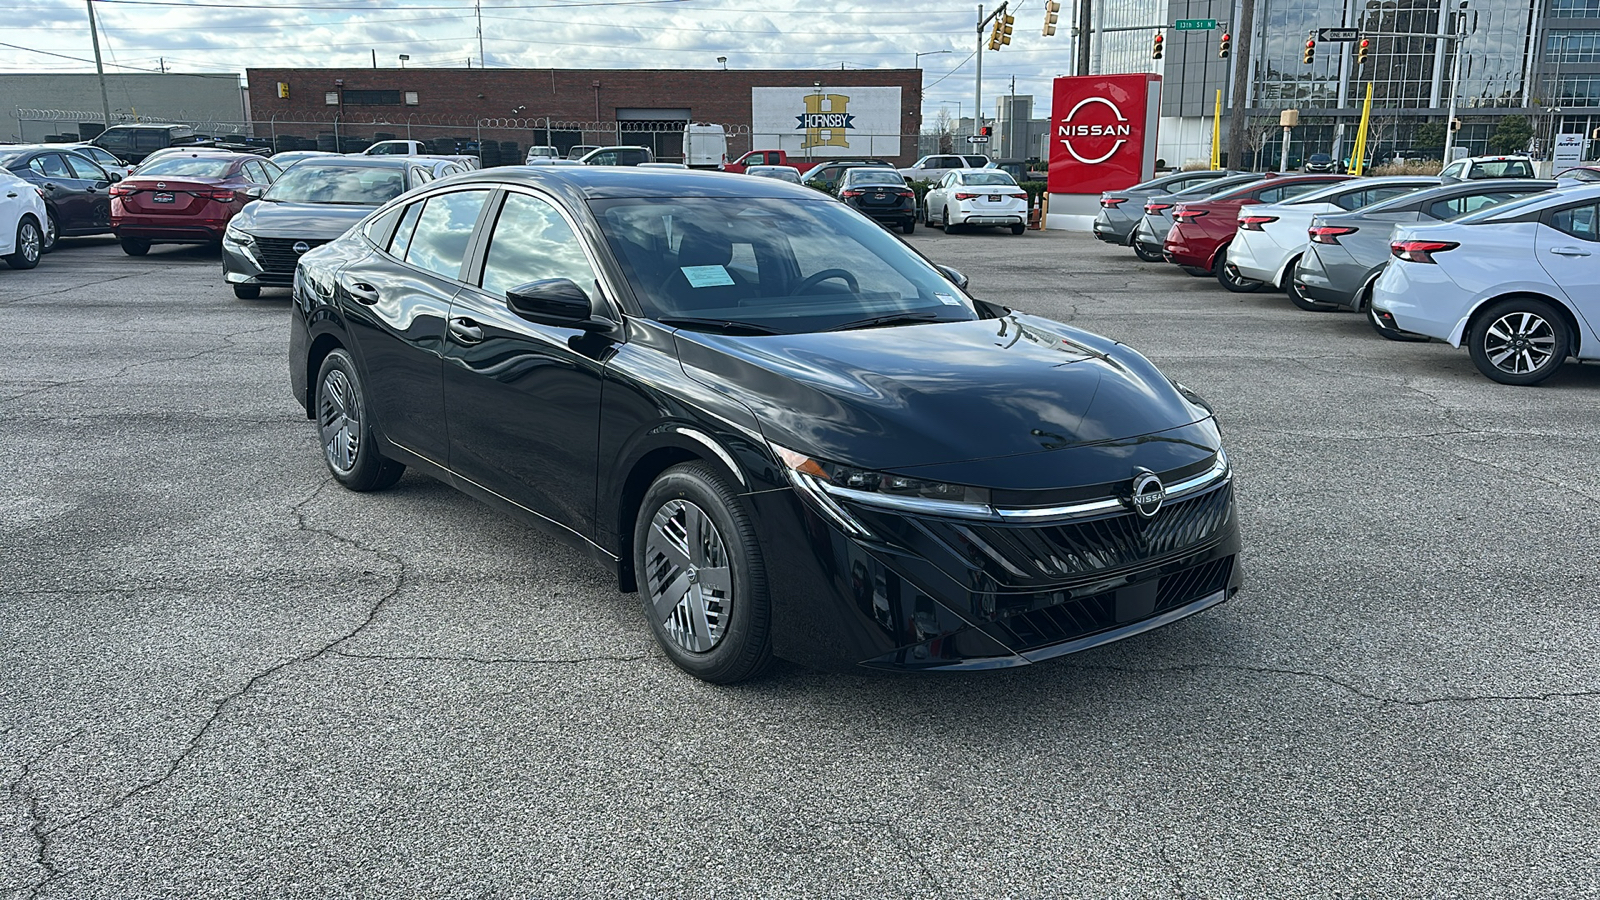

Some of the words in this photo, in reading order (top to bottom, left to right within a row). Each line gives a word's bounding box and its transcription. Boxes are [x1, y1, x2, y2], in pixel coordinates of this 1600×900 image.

[804, 114, 848, 128] HORNSBY
[1058, 124, 1130, 136] NISSAN
[1134, 491, 1166, 504] NISSAN
